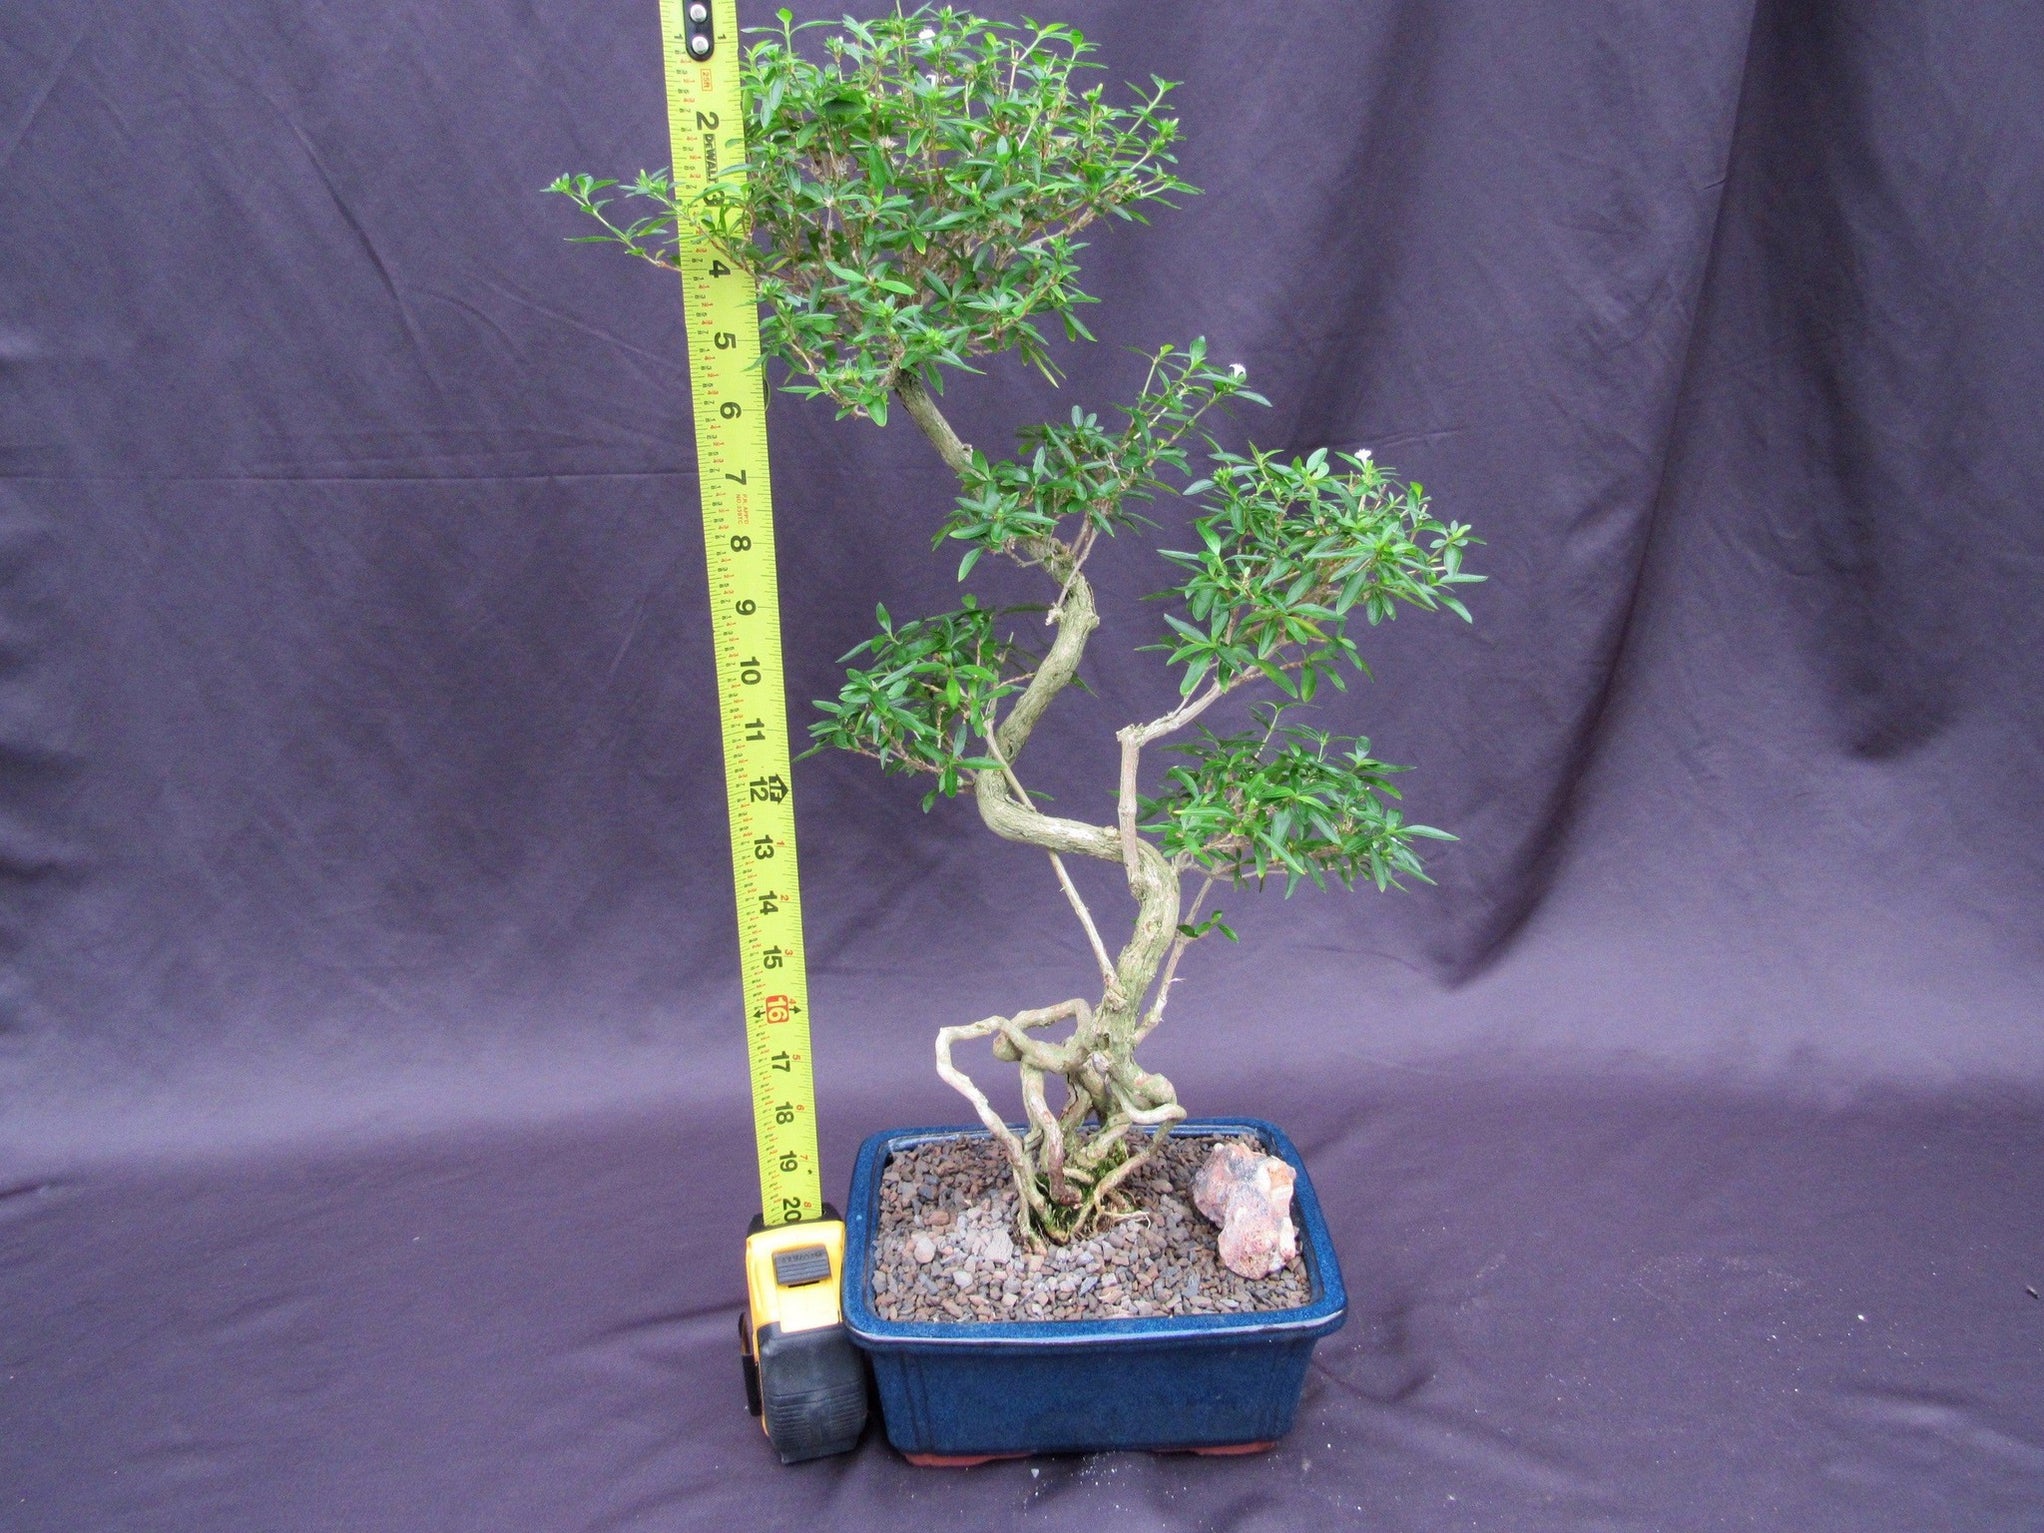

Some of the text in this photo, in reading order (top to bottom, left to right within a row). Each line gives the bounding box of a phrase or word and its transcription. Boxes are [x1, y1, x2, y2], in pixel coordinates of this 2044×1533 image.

[696, 111, 720, 130] 2
[709, 260, 731, 278] 4
[714, 332, 736, 350] 5
[720, 402, 742, 419] 6
[725, 469, 747, 485] 7
[730, 535, 752, 552] 8
[735, 599, 756, 616] 9
[740, 656, 761, 685] 10
[745, 718, 766, 741] 11
[749, 776, 769, 803] 12
[754, 834, 775, 860] 13
[759, 890, 779, 915] 14
[763, 945, 783, 969] 15
[767, 995, 789, 1022] 16
[771, 1051, 790, 1072] 17
[775, 1101, 795, 1125] 18
[779, 1150, 798, 1172] 19
[783, 1197, 802, 1222] 20
